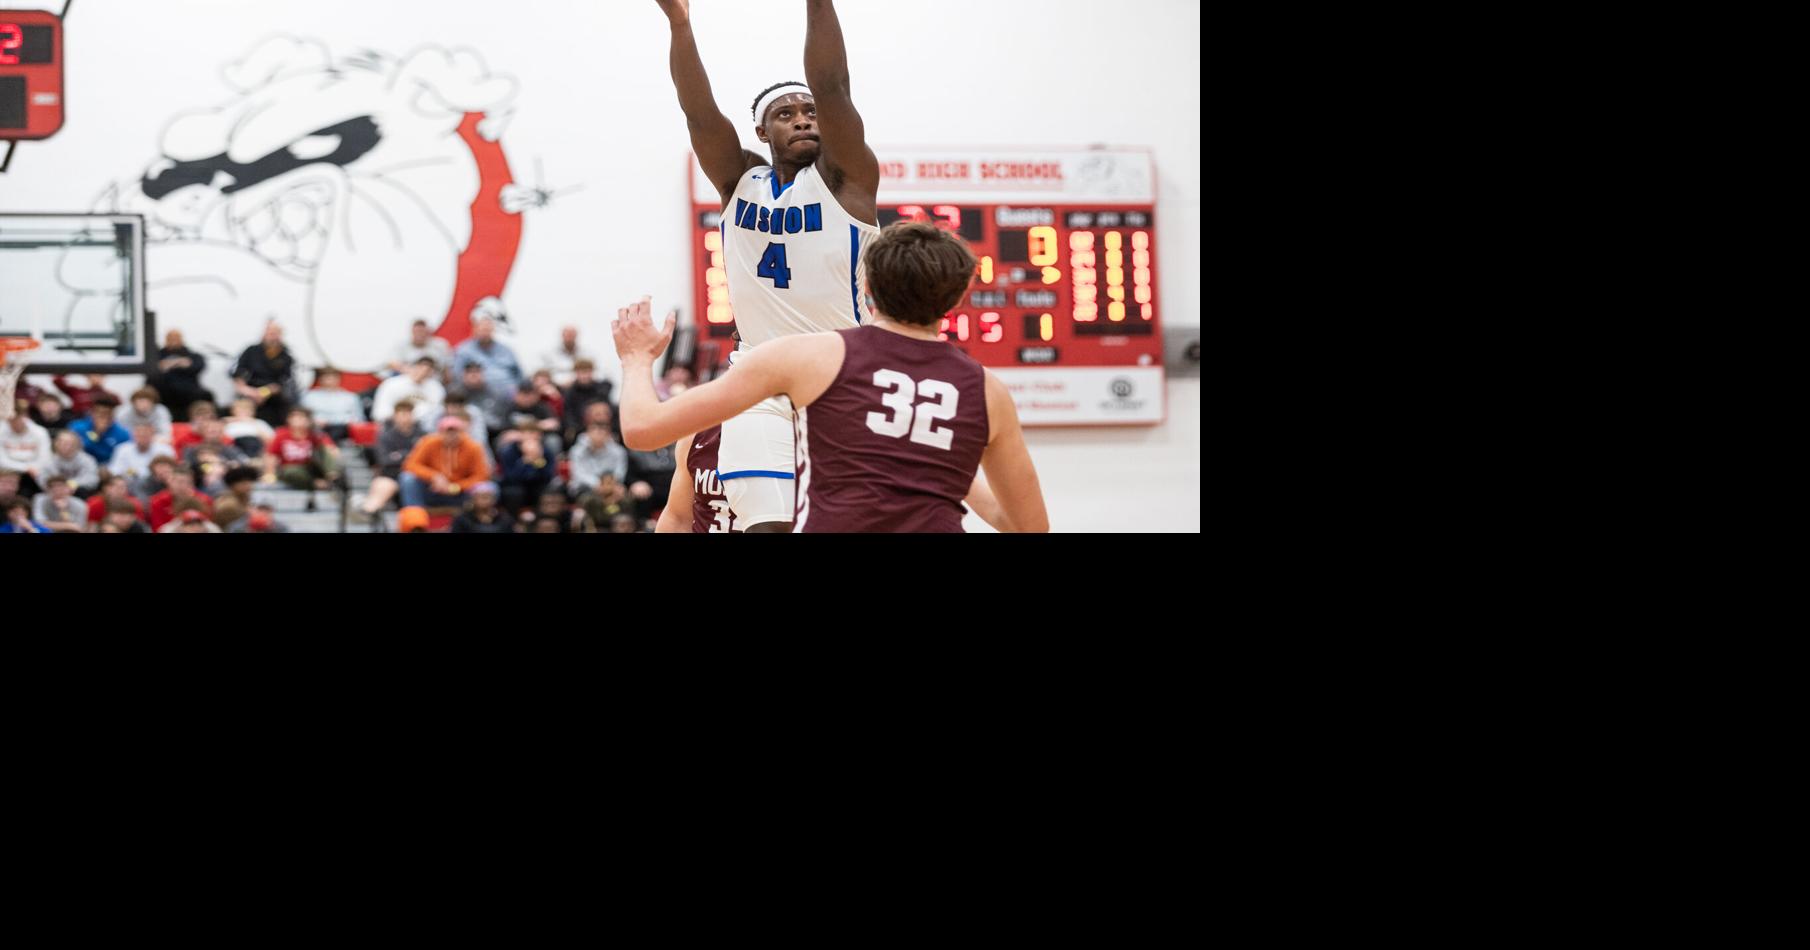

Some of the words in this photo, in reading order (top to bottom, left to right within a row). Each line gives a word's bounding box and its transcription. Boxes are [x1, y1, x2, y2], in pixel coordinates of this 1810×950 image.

[918, 163, 968, 178] HIGH
[980, 163, 1063, 179] SCHOOL
[735, 198, 822, 235] VASHON
[757, 242, 791, 289] 4
[866, 368, 959, 451] 32
[695, 468, 726, 495] MO
